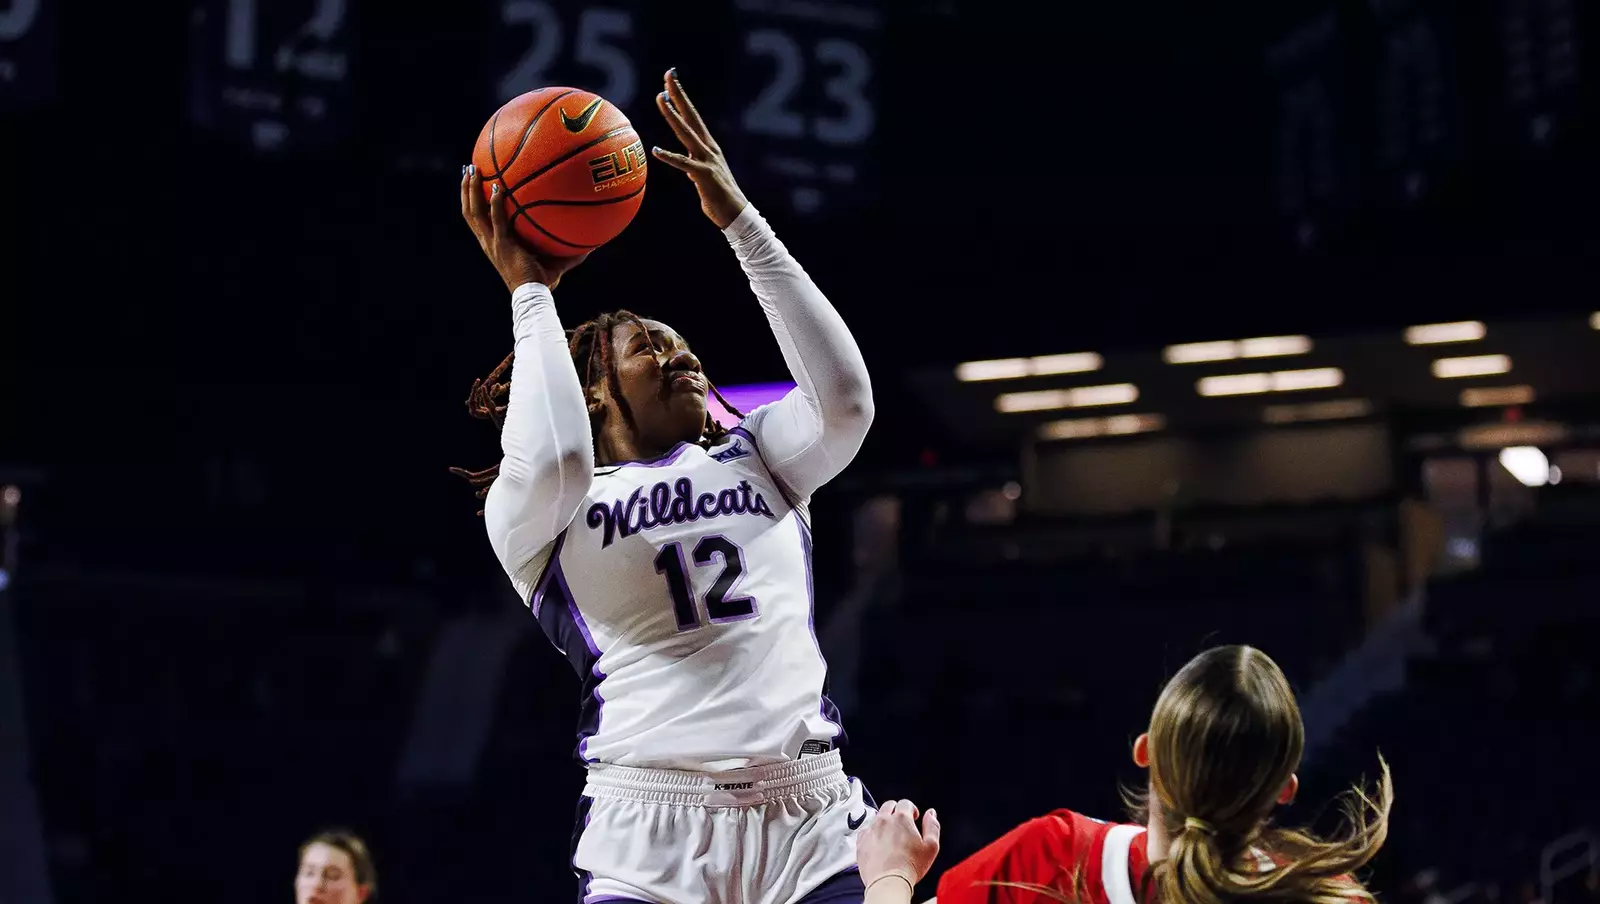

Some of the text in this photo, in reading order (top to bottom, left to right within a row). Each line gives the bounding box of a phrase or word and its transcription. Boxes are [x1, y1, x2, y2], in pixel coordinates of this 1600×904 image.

[499, 0, 639, 108] 25
[743, 29, 877, 146] 23
[588, 139, 647, 185] ELITE
[586, 477, 774, 549] Wildcats
[654, 534, 760, 630] 12
[714, 782, 753, 790] K-STATE
